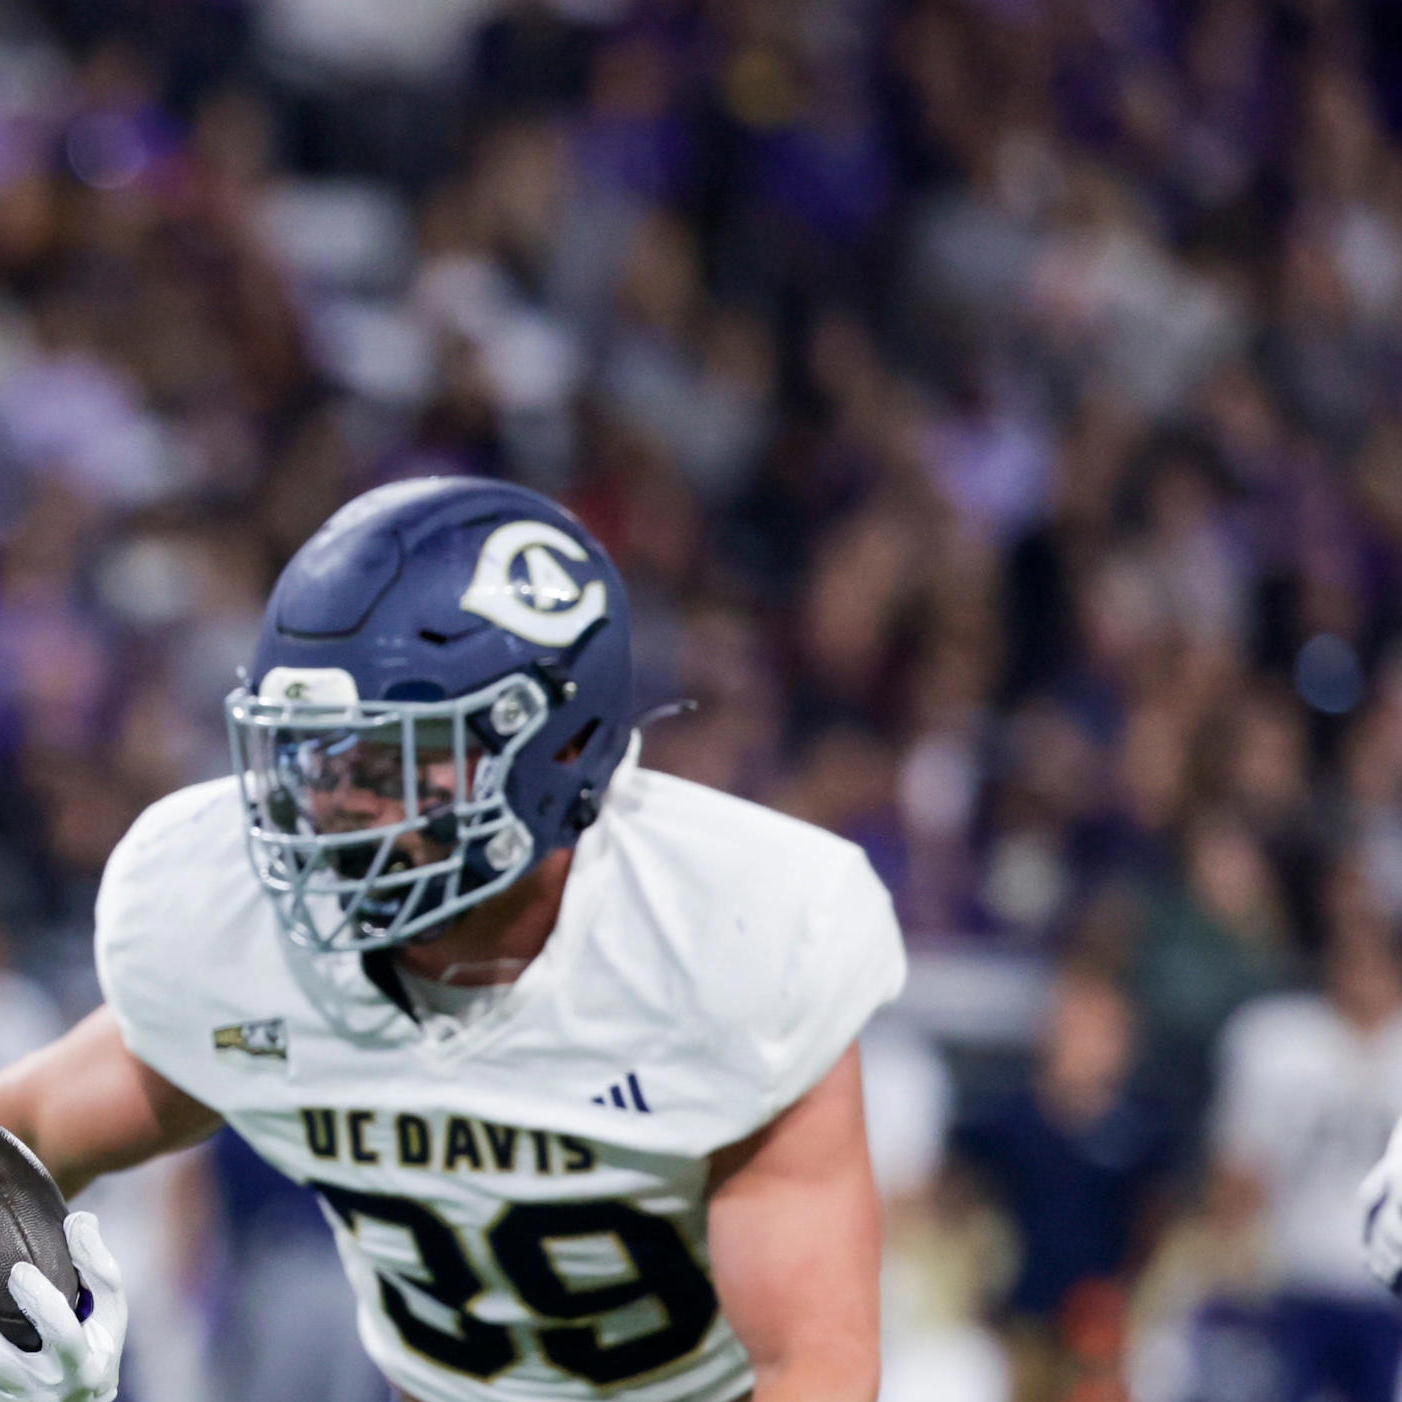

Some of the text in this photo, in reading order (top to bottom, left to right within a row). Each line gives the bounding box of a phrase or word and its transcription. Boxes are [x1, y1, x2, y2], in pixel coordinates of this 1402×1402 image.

[300, 1108, 597, 1176] UC DAVIS
[310, 1182, 720, 1387] 39
